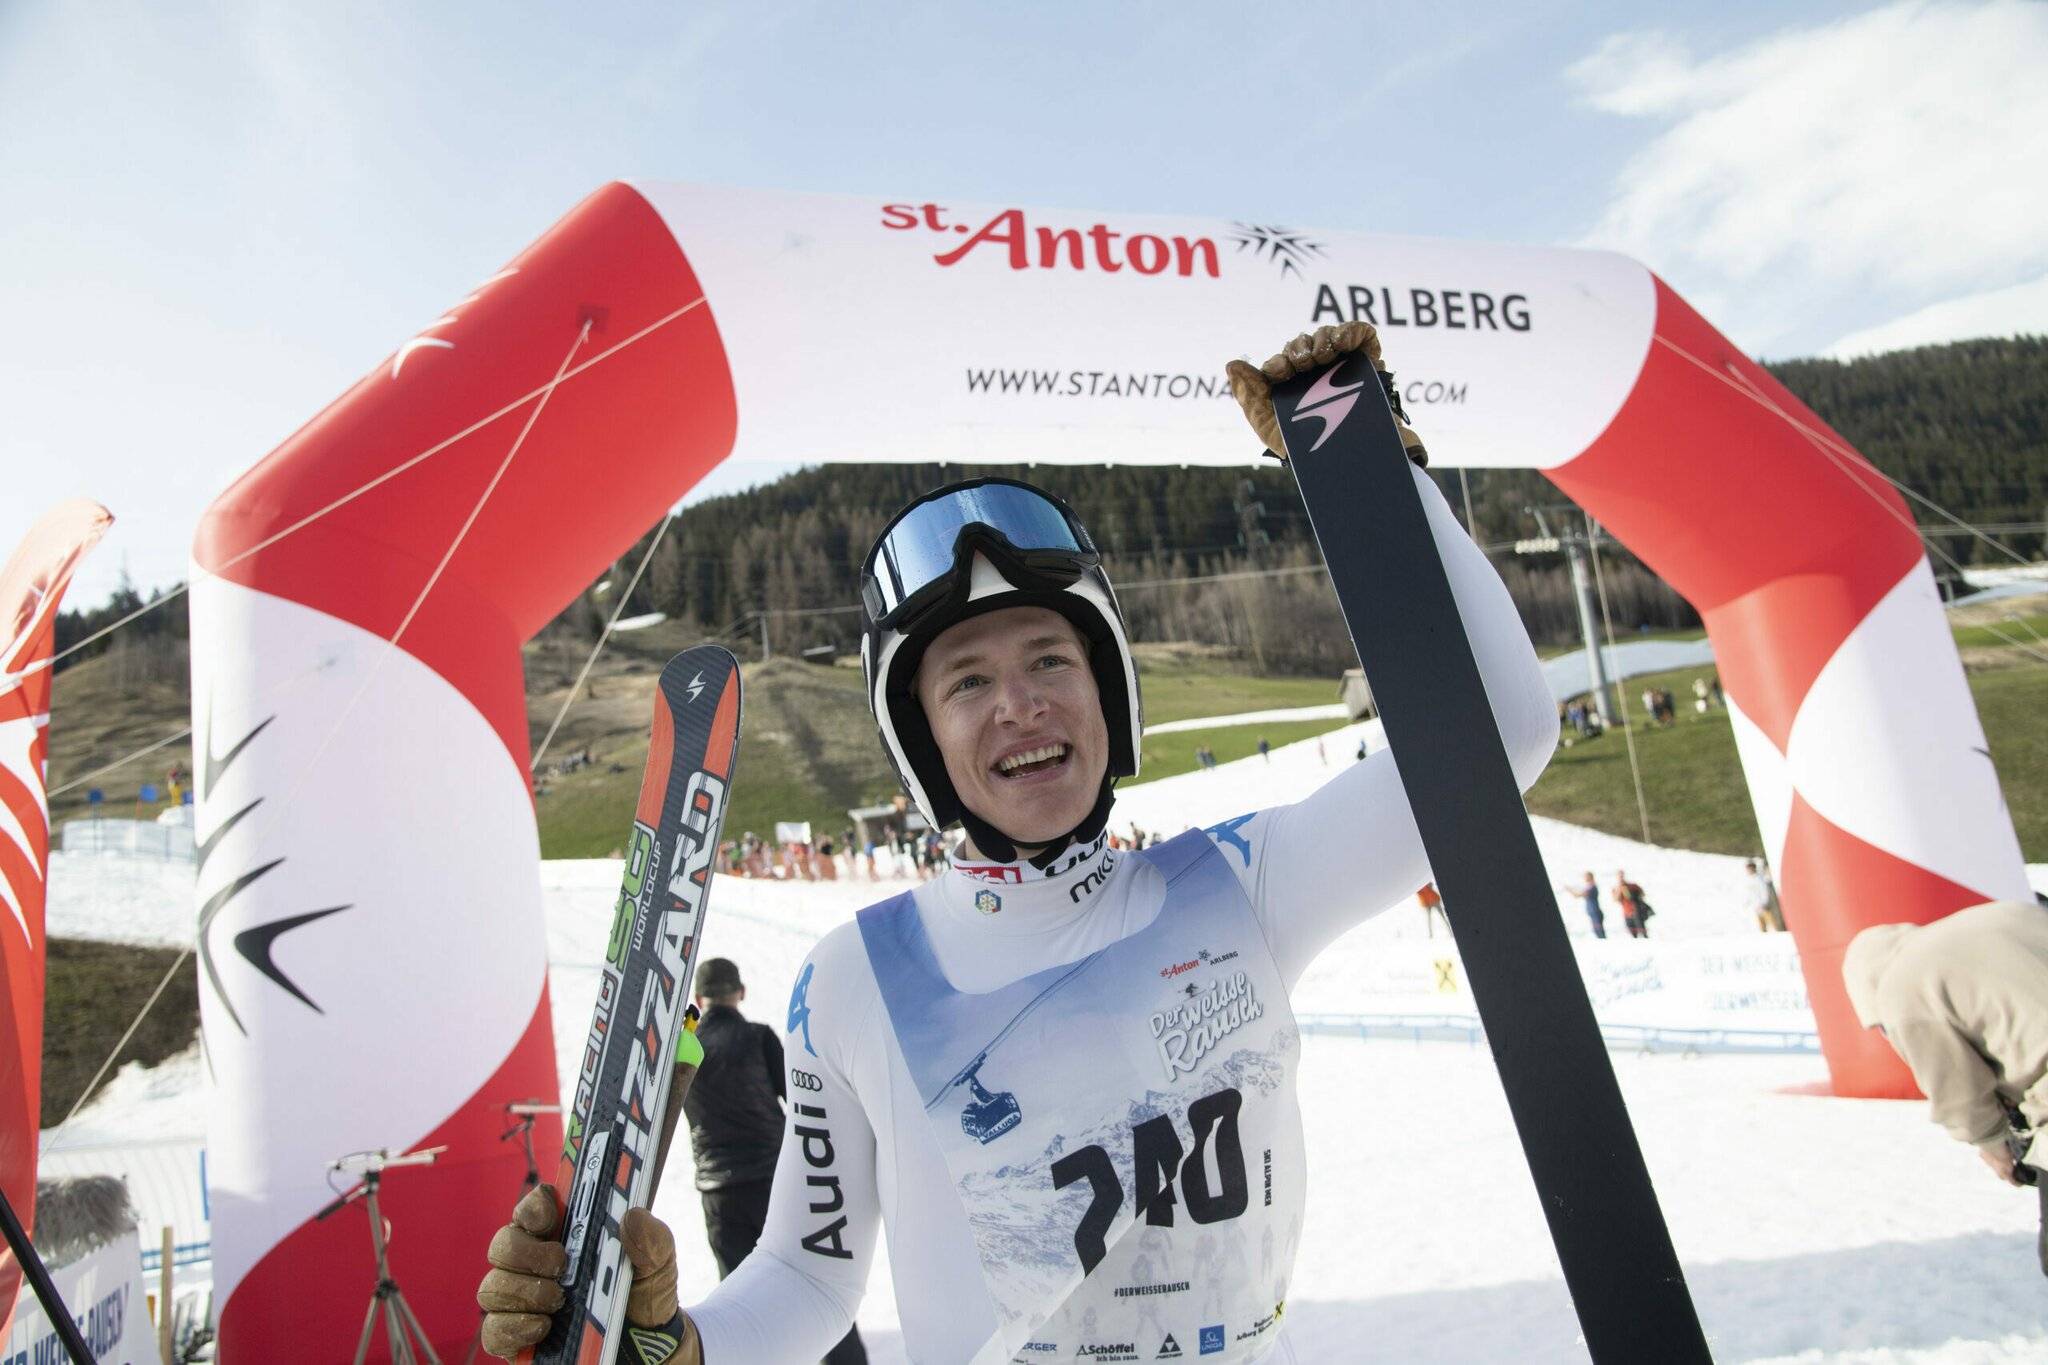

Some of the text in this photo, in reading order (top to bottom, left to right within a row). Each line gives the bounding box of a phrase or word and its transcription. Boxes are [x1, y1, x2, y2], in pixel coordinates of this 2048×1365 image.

[1312, 284, 1531, 331] ARLBERG
[1209, 951, 1239, 966] ARLBERG
[561, 825, 653, 1164] RACING SG
[1149, 971, 1247, 1039] Der weisse
[1158, 982, 1264, 1084] Rausch
[794, 1102, 853, 1259] Audi
[1114, 1281, 1190, 1298] #DERWEISSERAUSCH
[1088, 1343, 1135, 1355] Schöffel
